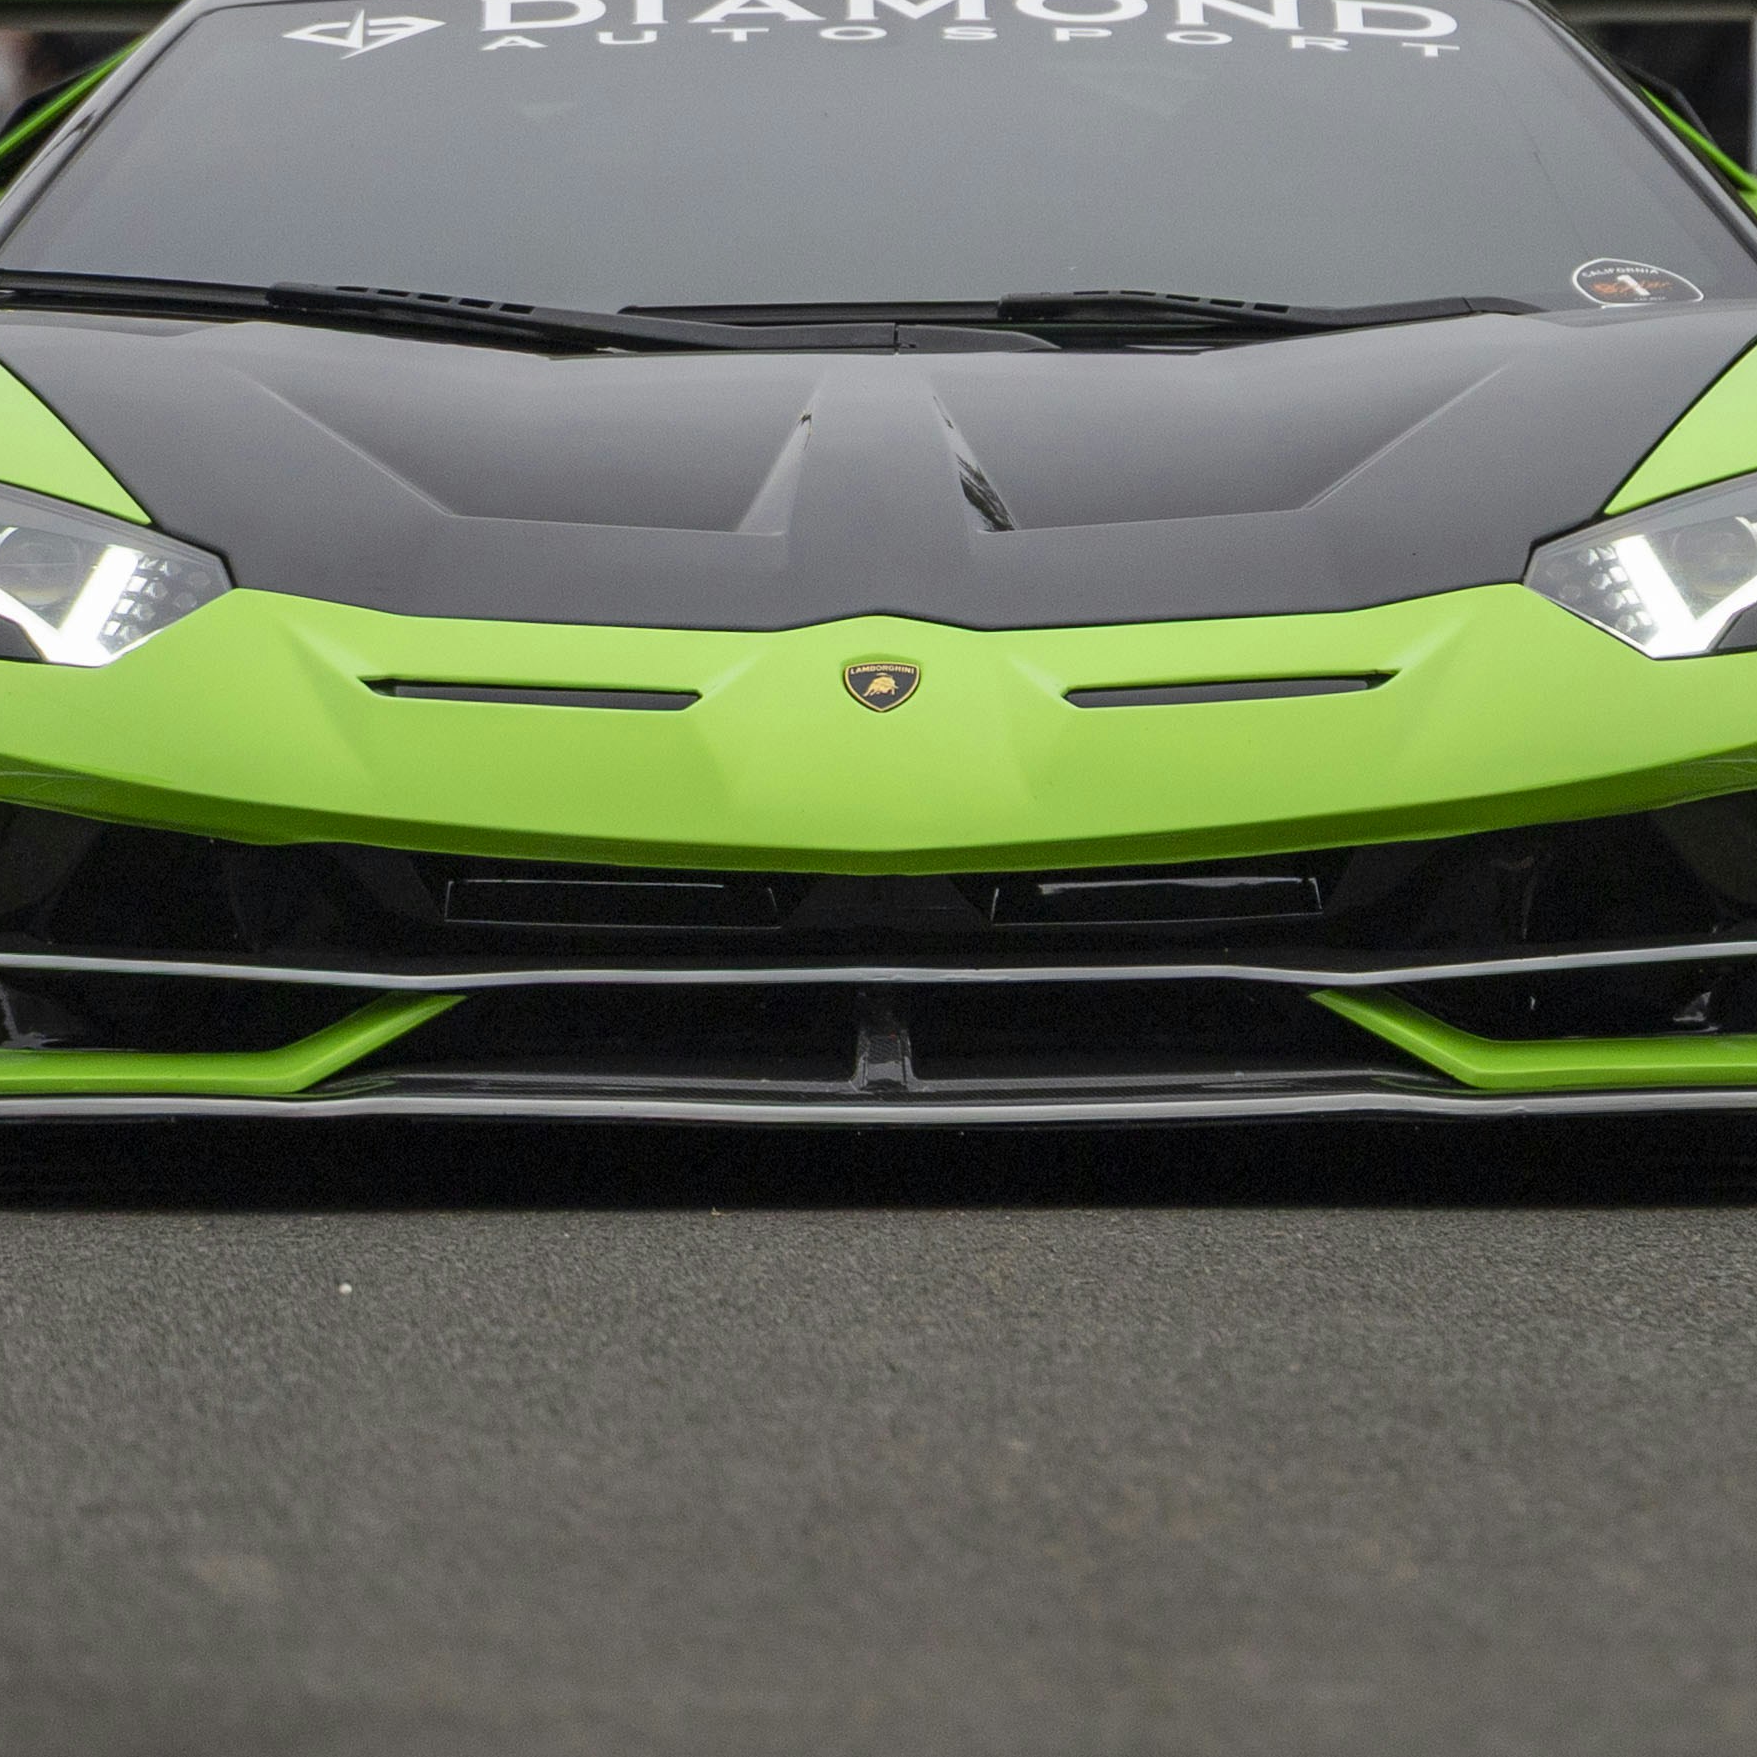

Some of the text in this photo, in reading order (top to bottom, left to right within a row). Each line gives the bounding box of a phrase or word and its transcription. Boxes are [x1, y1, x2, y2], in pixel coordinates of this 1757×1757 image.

[478, 25, 1461, 58] AUTOSPORT
[1581, 266, 1660, 278] CALIFORNIA
[850, 664, 915, 675] LAMBORGHINI
